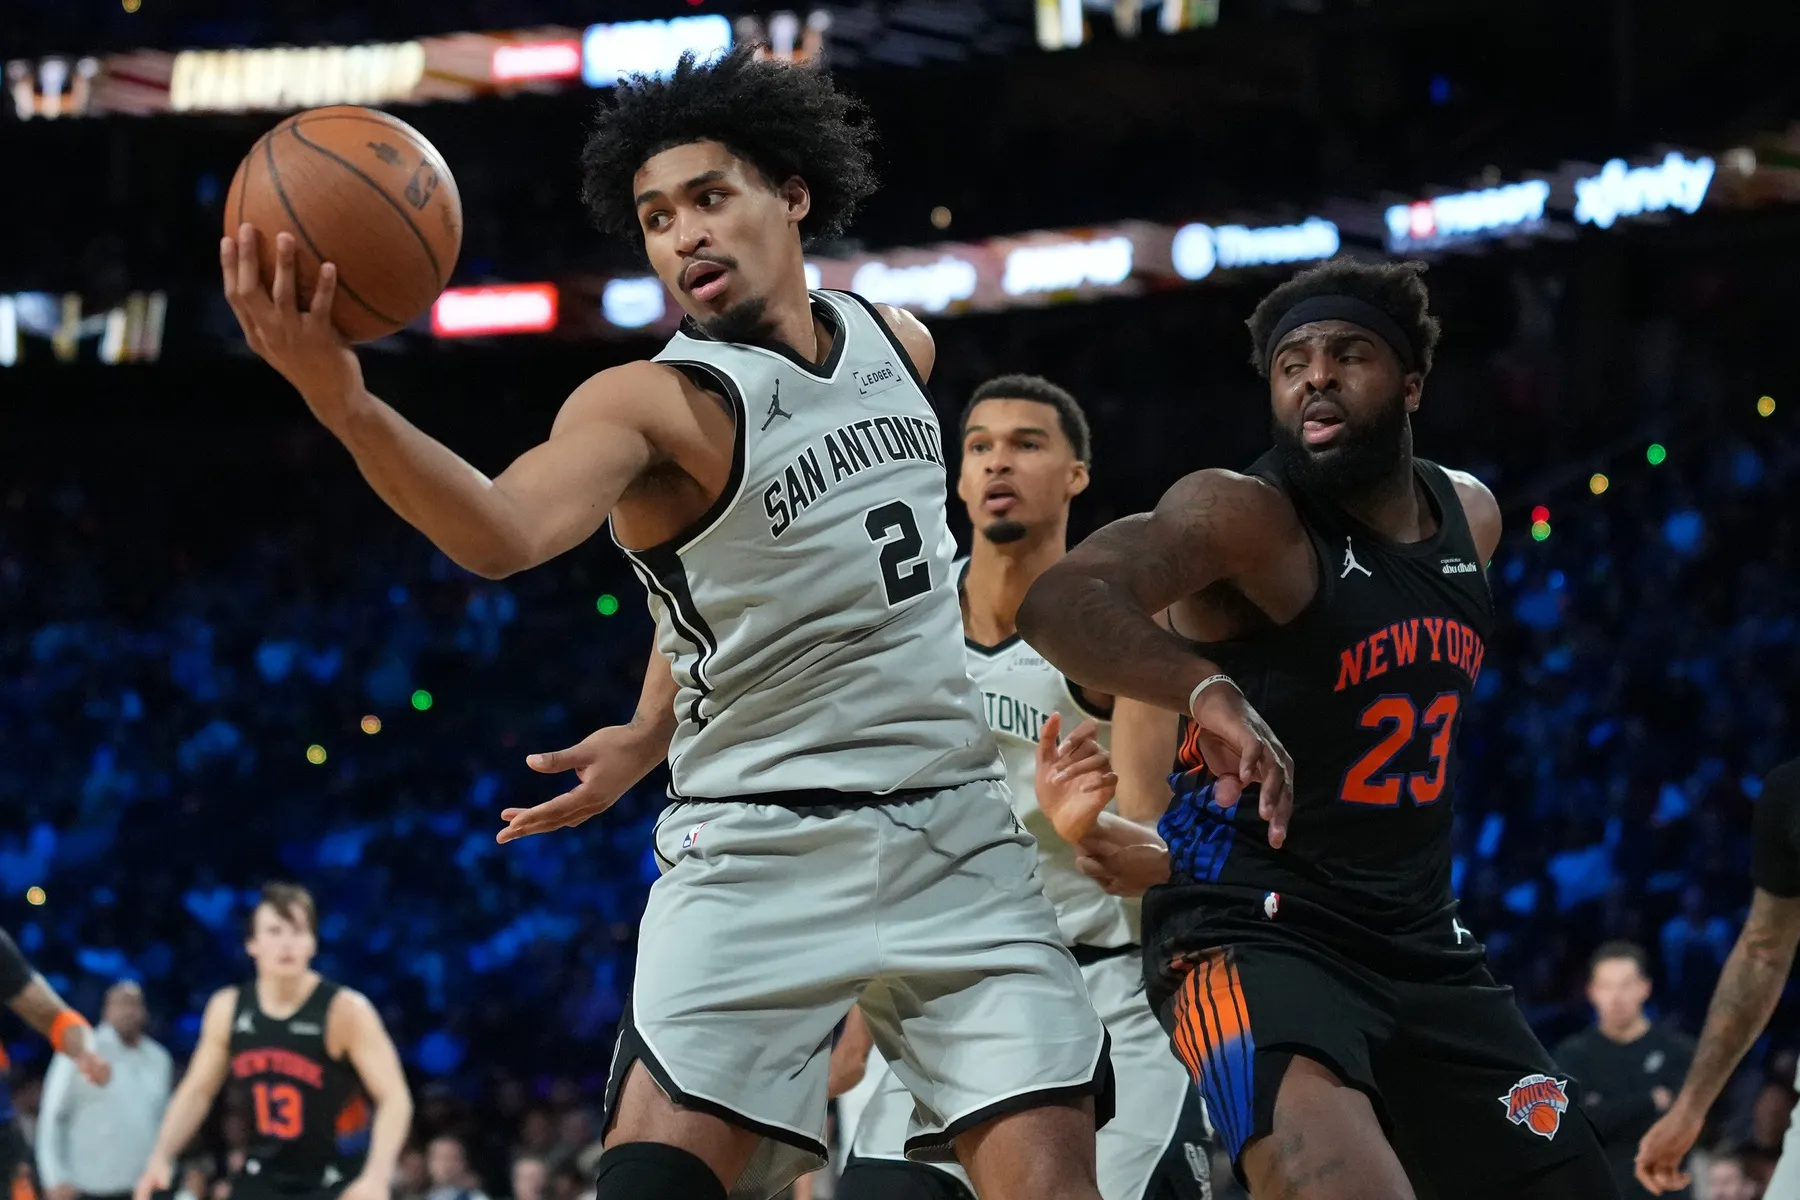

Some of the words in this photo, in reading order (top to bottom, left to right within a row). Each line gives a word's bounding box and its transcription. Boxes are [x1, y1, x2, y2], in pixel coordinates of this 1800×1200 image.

[861, 368, 894, 387] LEDGER
[763, 446, 828, 540] SAN
[863, 498, 934, 609] 2
[1334, 617, 1420, 692] NEW
[1423, 616, 1485, 690] YORK
[980, 690, 1051, 745] TONI
[1337, 691, 1460, 808] 23
[251, 1081, 304, 1138] 13
[1509, 1080, 1566, 1117] KNICKS
